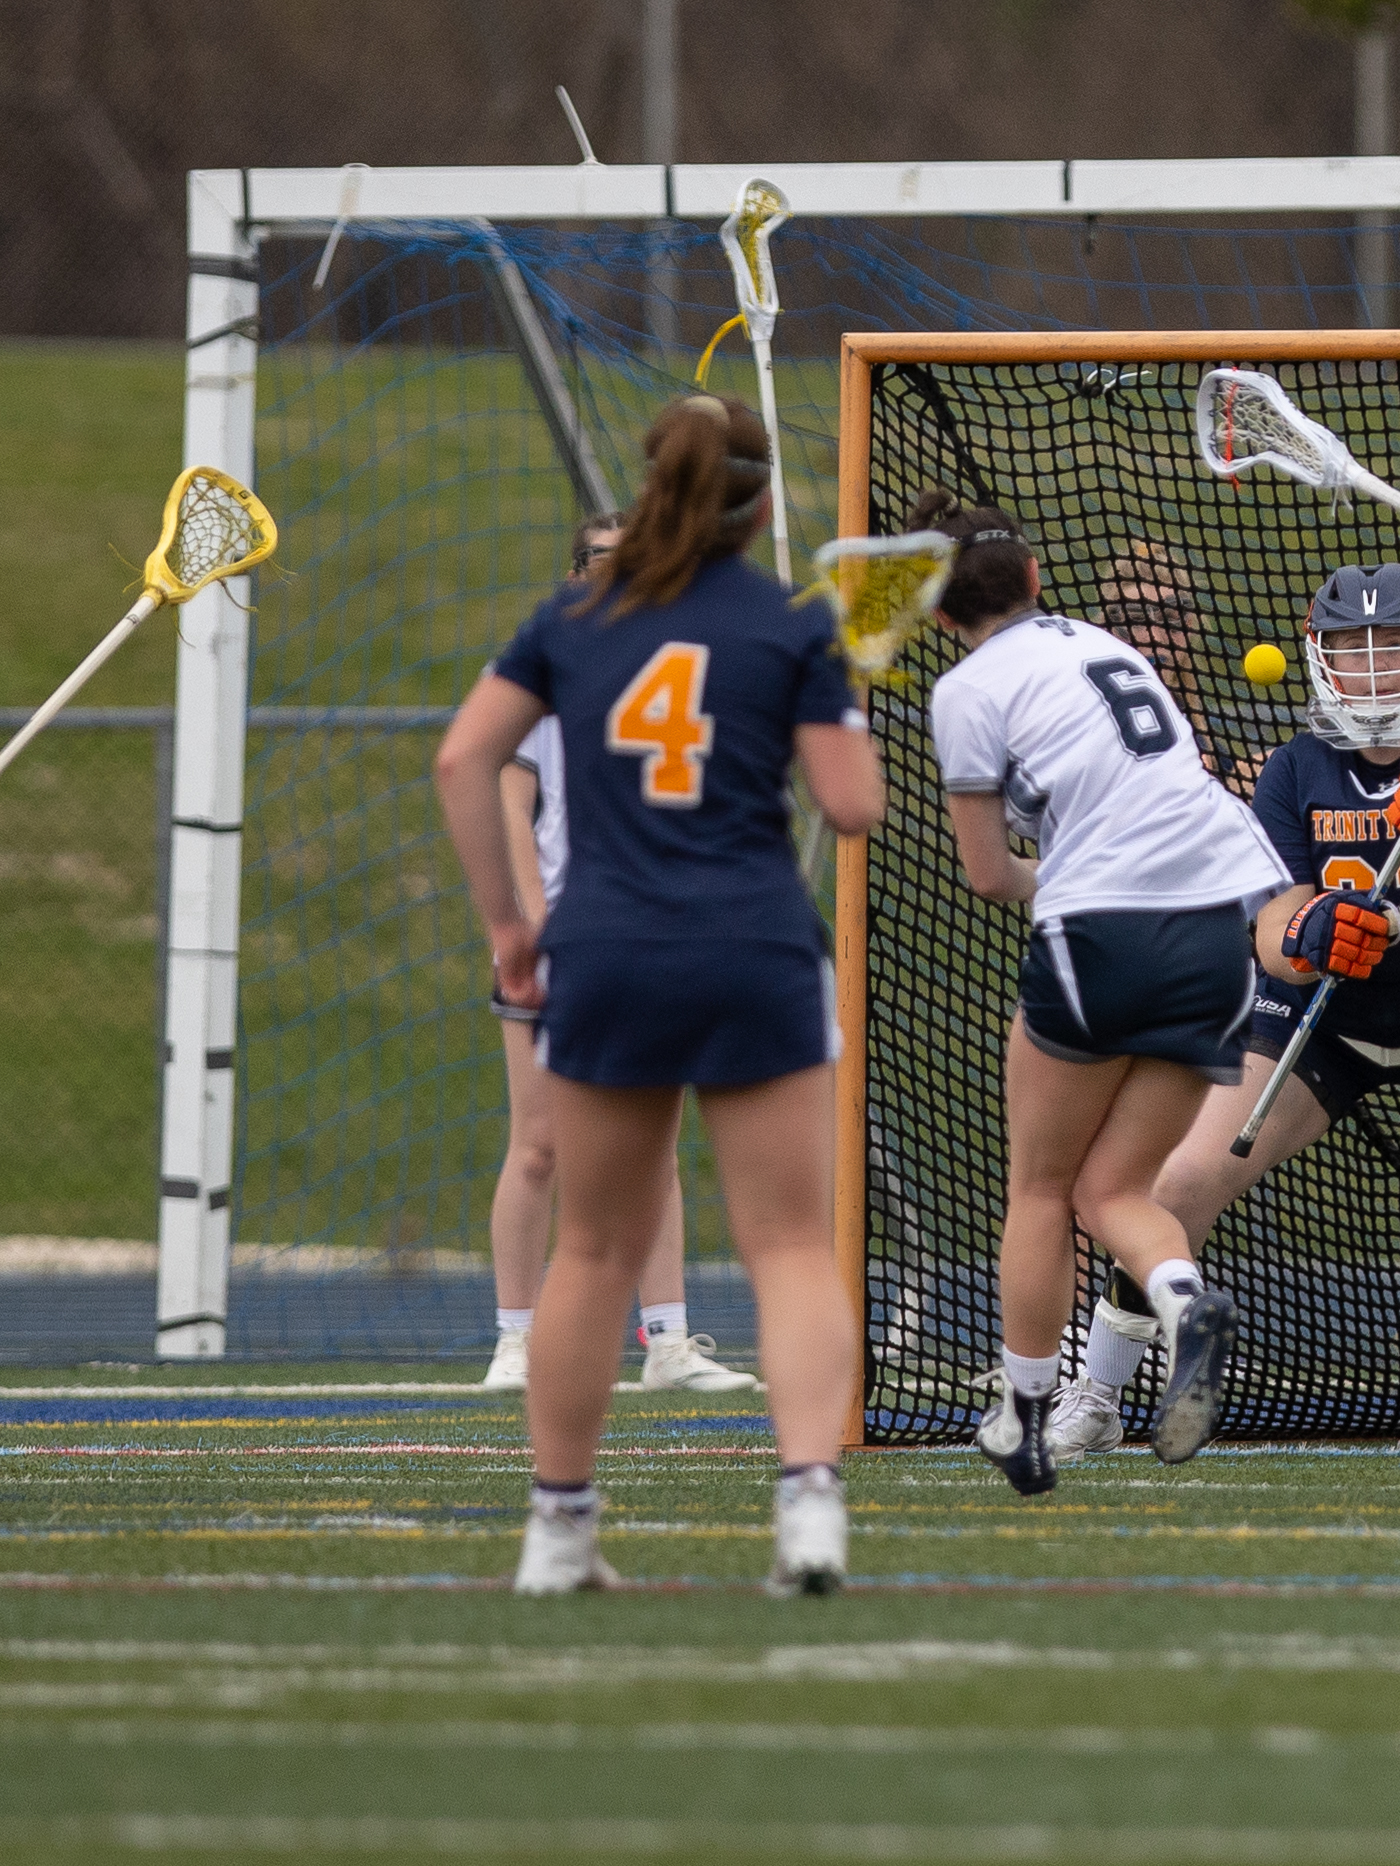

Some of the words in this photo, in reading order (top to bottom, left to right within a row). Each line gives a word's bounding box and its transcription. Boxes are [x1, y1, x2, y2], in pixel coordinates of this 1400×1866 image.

[976, 529, 1011, 541] STX
[605, 641, 716, 810] 4
[1080, 654, 1182, 762] 6
[1311, 808, 1396, 842] TRINITY
